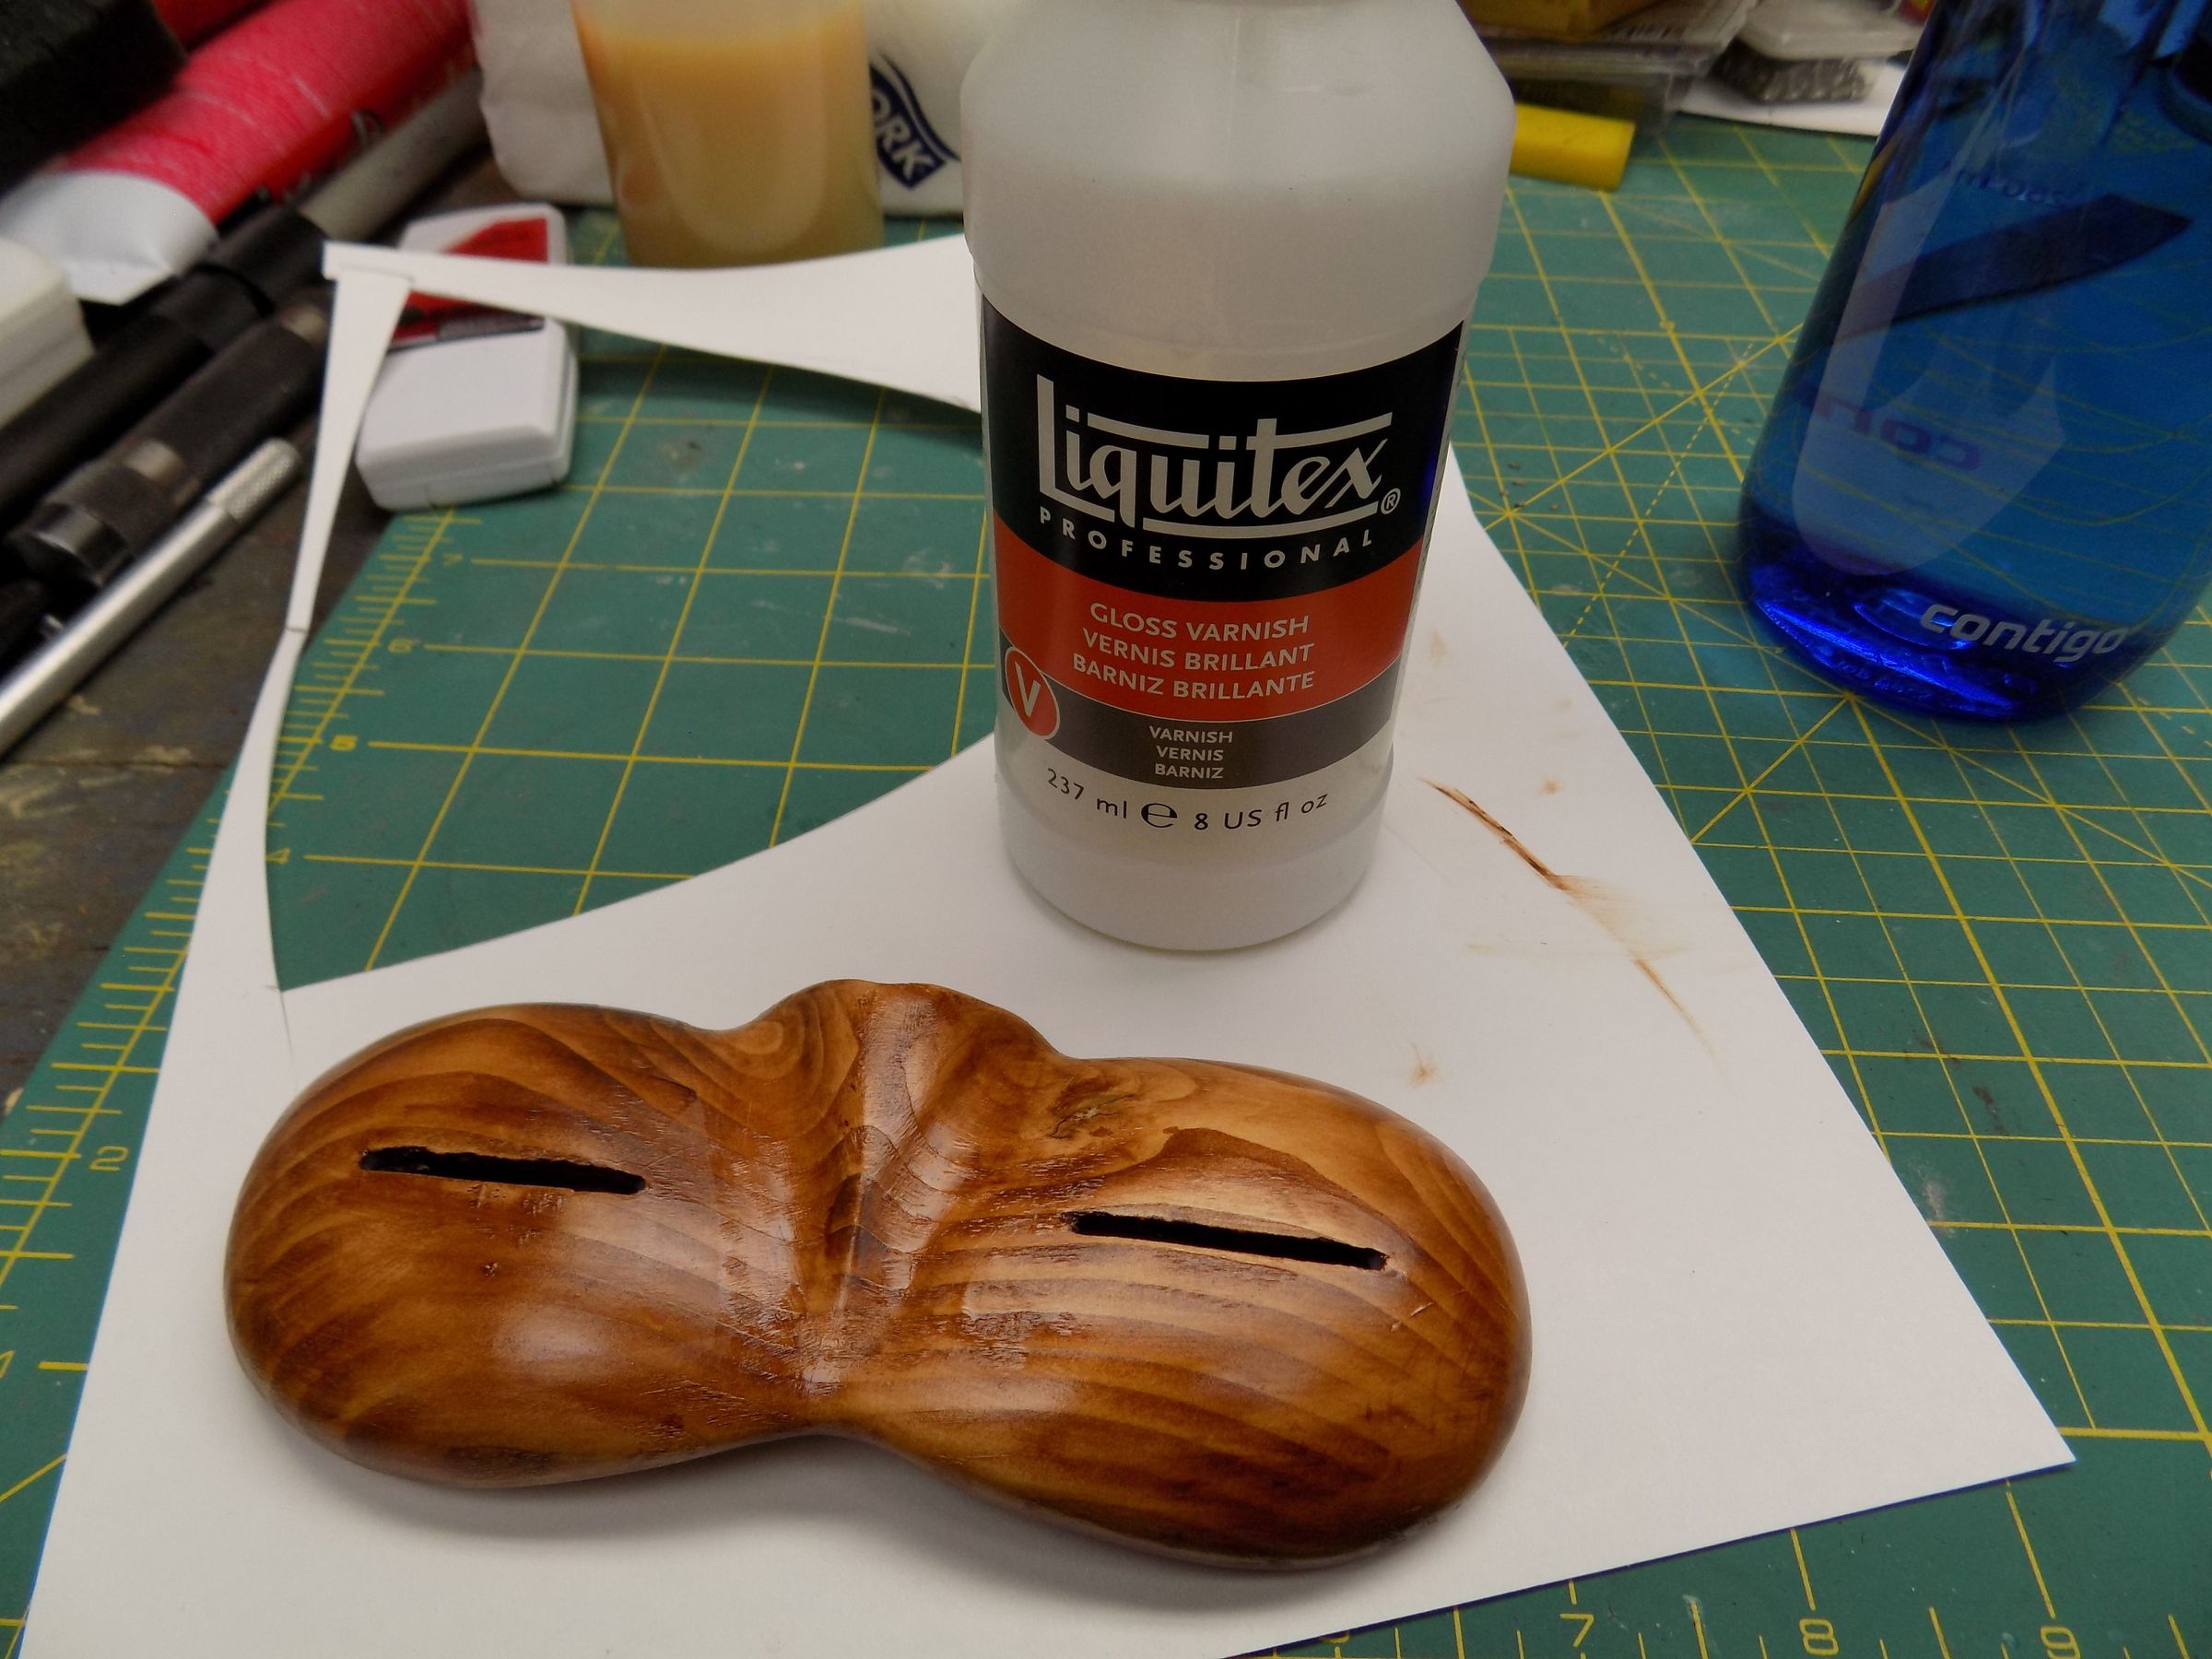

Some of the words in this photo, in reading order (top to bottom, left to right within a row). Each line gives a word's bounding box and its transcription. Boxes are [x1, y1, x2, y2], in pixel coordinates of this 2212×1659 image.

[1037, 374, 1393, 539] Liquitex
[1040, 506, 1372, 570] PROFESSIONAL
[1090, 603, 1177, 639] GLOSS
[1186, 615, 1309, 641] VARNISH
[1920, 604, 2128, 662] contigo
[1082, 628, 1176, 668] VERNIS
[1185, 643, 1314, 672] BRILLANT
[1014, 660, 1041, 718] V
[1073, 653, 1164, 696] BARNIZ
[1173, 671, 1314, 700] BRILLANTE
[1148, 725, 1233, 744] VARNISH
[1156, 746, 1224, 761] VERNIS
[1154, 763, 1224, 779] BARNIZ
[1046, 768, 1085, 800] 237
[1097, 798, 1127, 818] ml
[1194, 813, 1209, 830] 8
[1224, 809, 1262, 830] US
[1276, 802, 1289, 822] fl
[1300, 794, 1328, 814] oz
[89, 1145, 129, 1171] 2
[1559, 1613, 1594, 1647] 7
[1799, 1618, 1839, 1655] 8
[2040, 1625, 2081, 1659] 9
